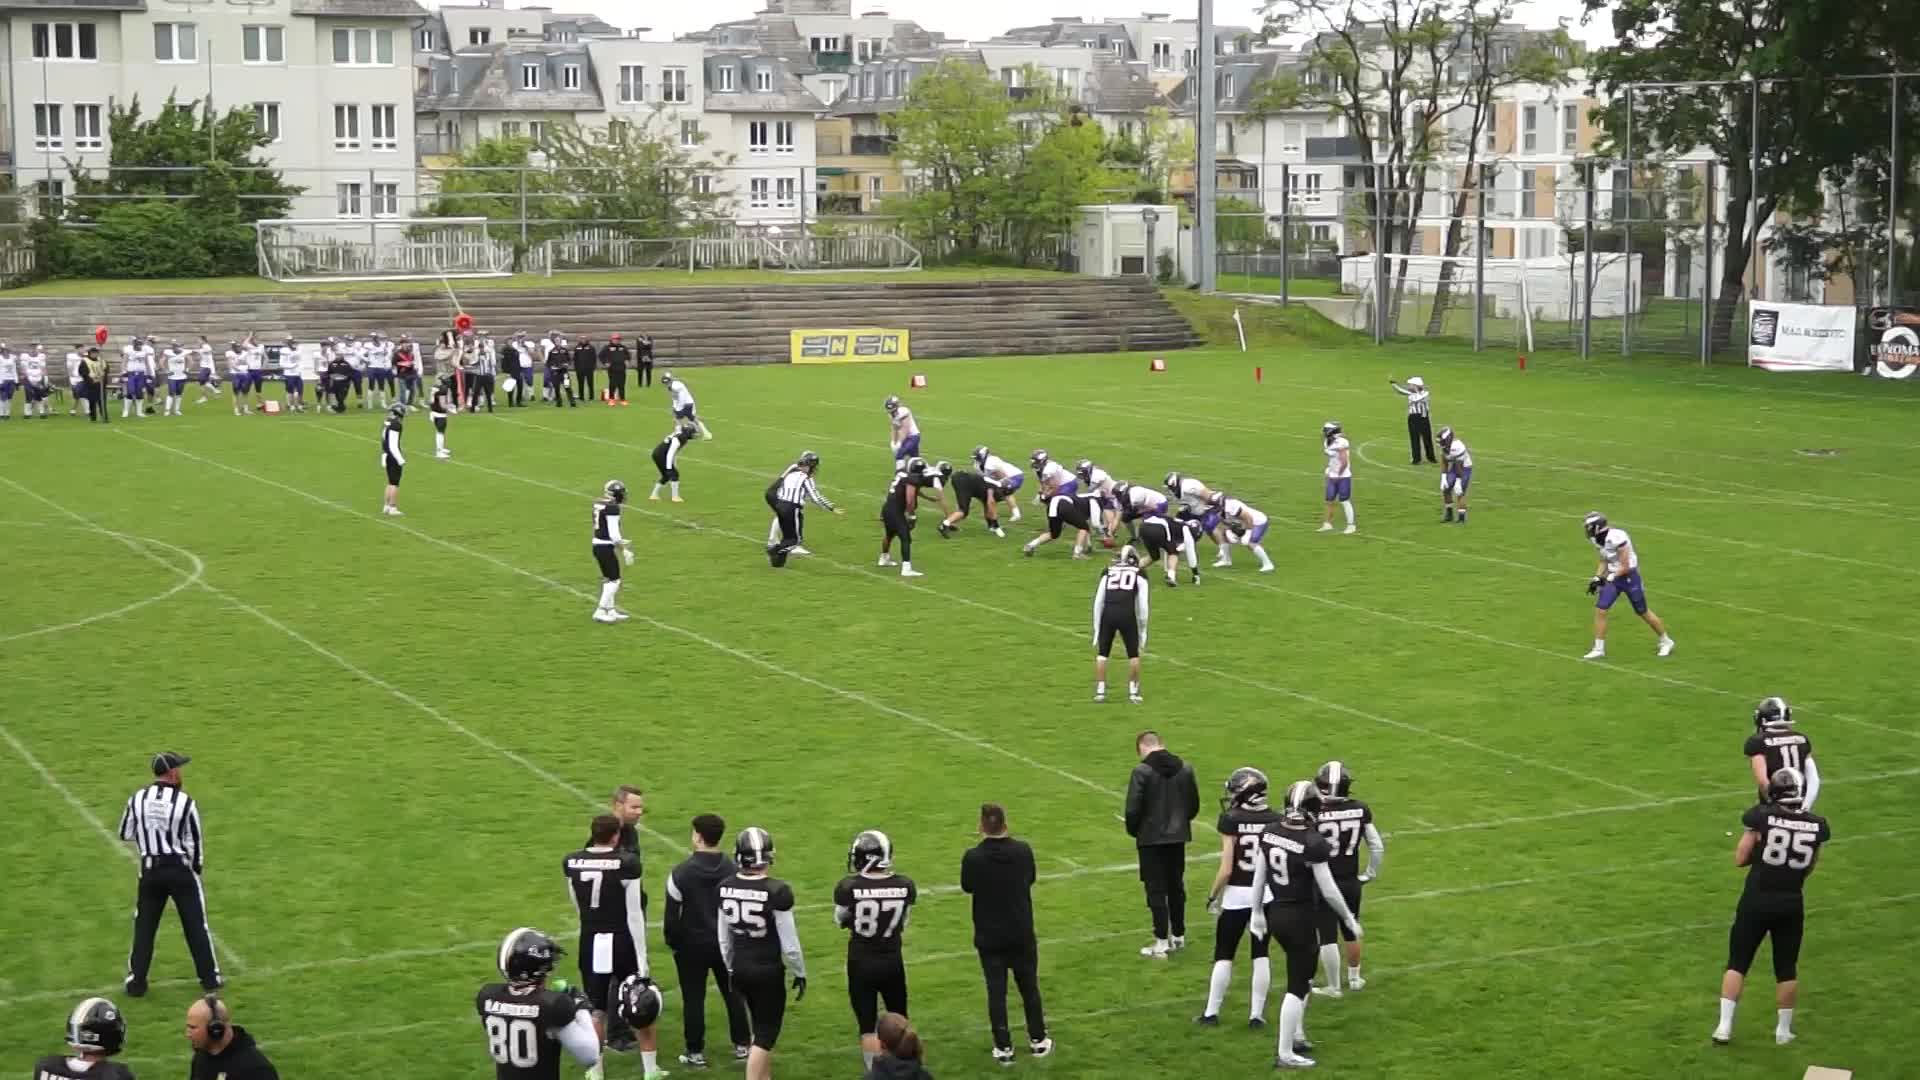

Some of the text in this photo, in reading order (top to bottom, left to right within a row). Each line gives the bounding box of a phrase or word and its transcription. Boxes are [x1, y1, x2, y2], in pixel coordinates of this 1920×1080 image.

[1107, 570, 1136, 590] 20
[1238, 835, 1260, 871] 3
[1318, 820, 1362, 857] 37
[1762, 828, 1817, 869] 85
[1269, 846, 1289, 886] 9
[580, 871, 603, 908] 7
[722, 899, 767, 938] 25
[854, 900, 905, 938] 87
[485, 1015, 540, 1069] 80
